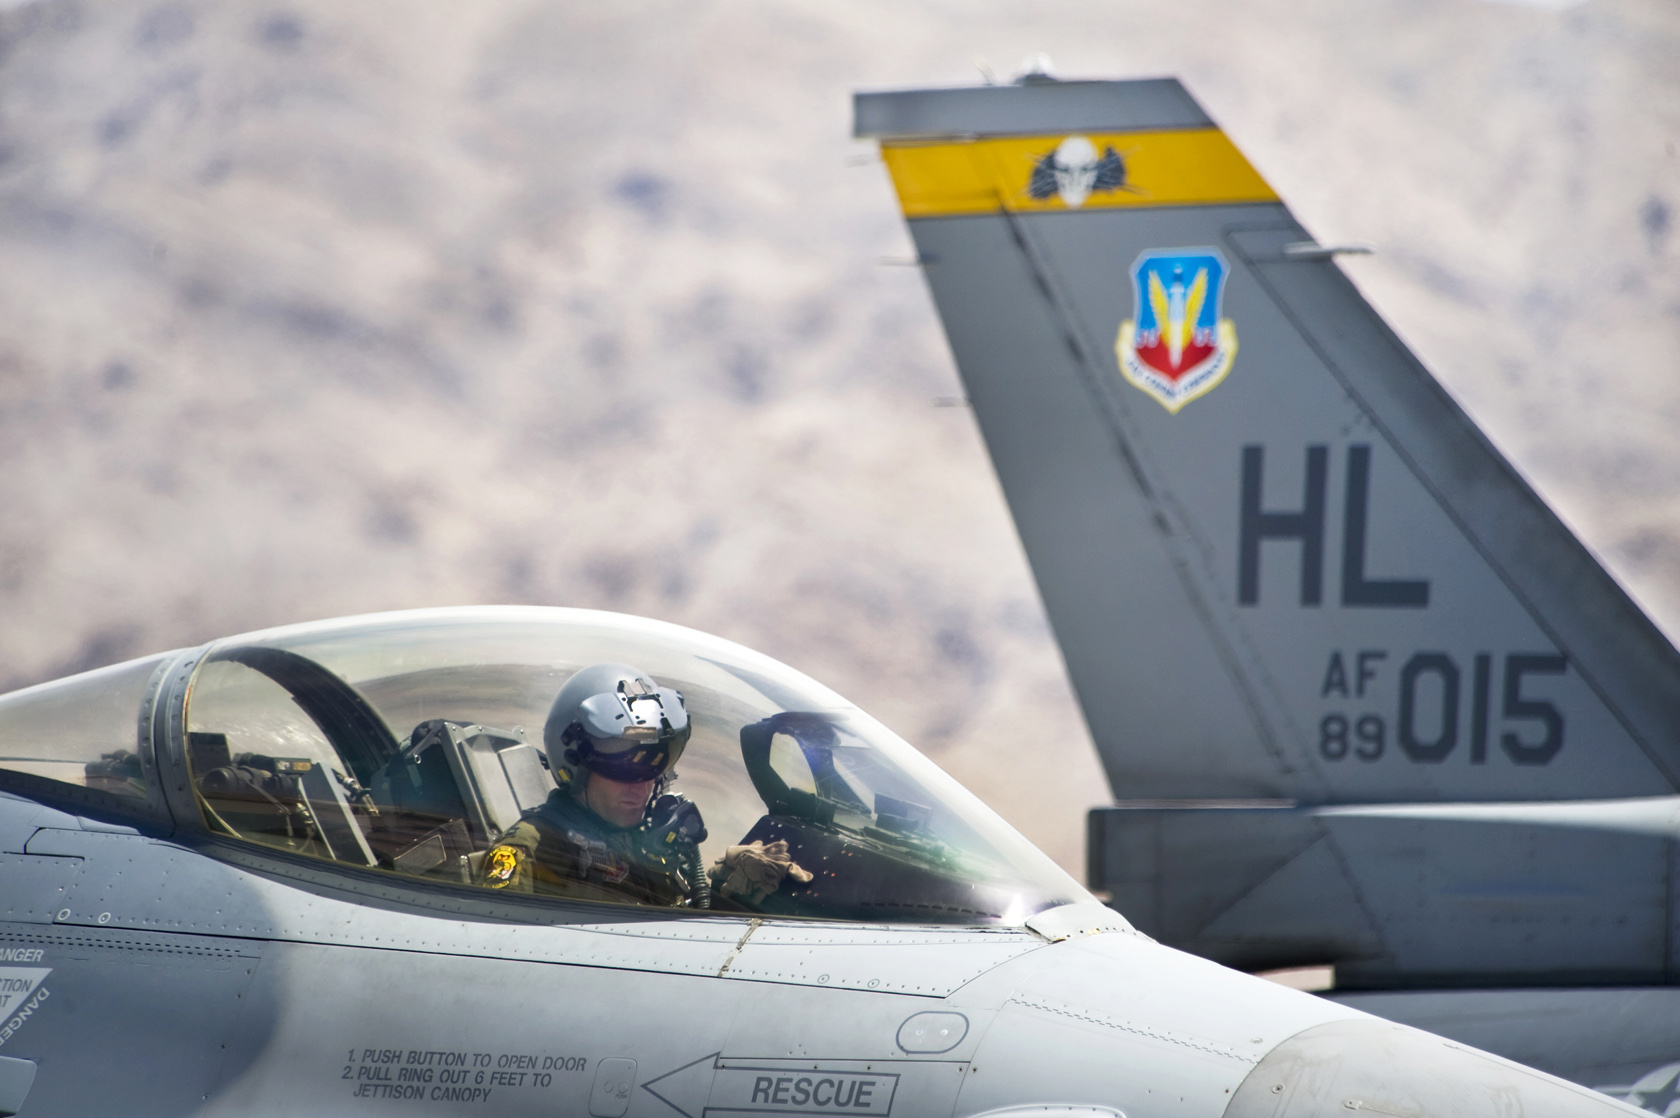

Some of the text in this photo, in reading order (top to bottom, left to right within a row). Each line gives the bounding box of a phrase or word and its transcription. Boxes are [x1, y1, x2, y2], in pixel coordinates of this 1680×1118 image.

[1238, 443, 1432, 608] HL
[1321, 651, 1388, 698] AF
[1398, 651, 1573, 767] 015
[1319, 713, 1387, 763] 89
[0, 978, 32, 992] TION
[348, 1048, 587, 1071] 1. PUSH BUTTON TO OPEN DOOR
[341, 1065, 552, 1088] 2. PULL RING OUT 6 FEET TO
[751, 1076, 876, 1108] RESCUE
[353, 1083, 492, 1103] JETTISON CANOPY
